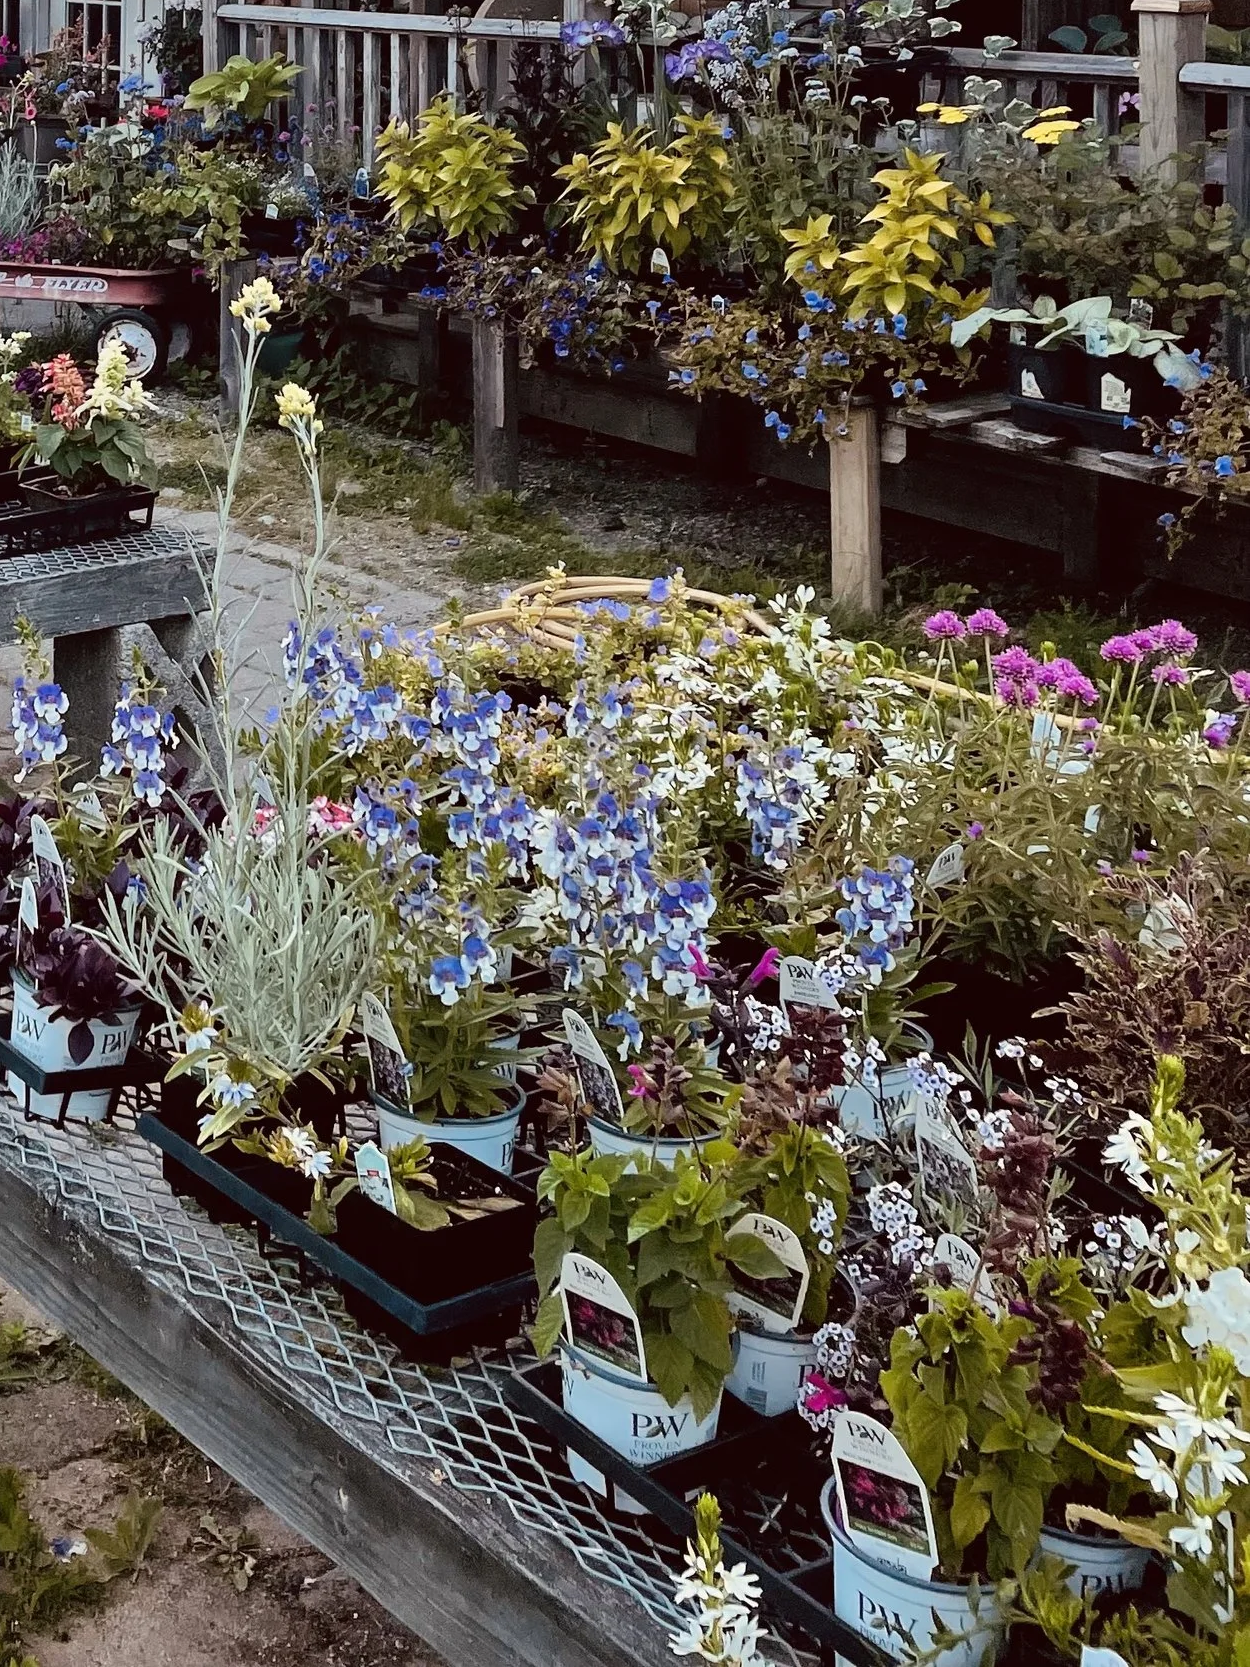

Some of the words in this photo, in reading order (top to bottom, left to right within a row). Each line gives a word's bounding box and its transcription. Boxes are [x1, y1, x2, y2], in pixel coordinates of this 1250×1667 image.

[40, 276, 108, 292] FLYER
[786, 964, 814, 980] PW
[16, 1010, 46, 1042] PW
[631, 1413, 689, 1439] PW
[846, 1420, 886, 1446] PW
[634, 1440, 681, 1450] PROVEN
